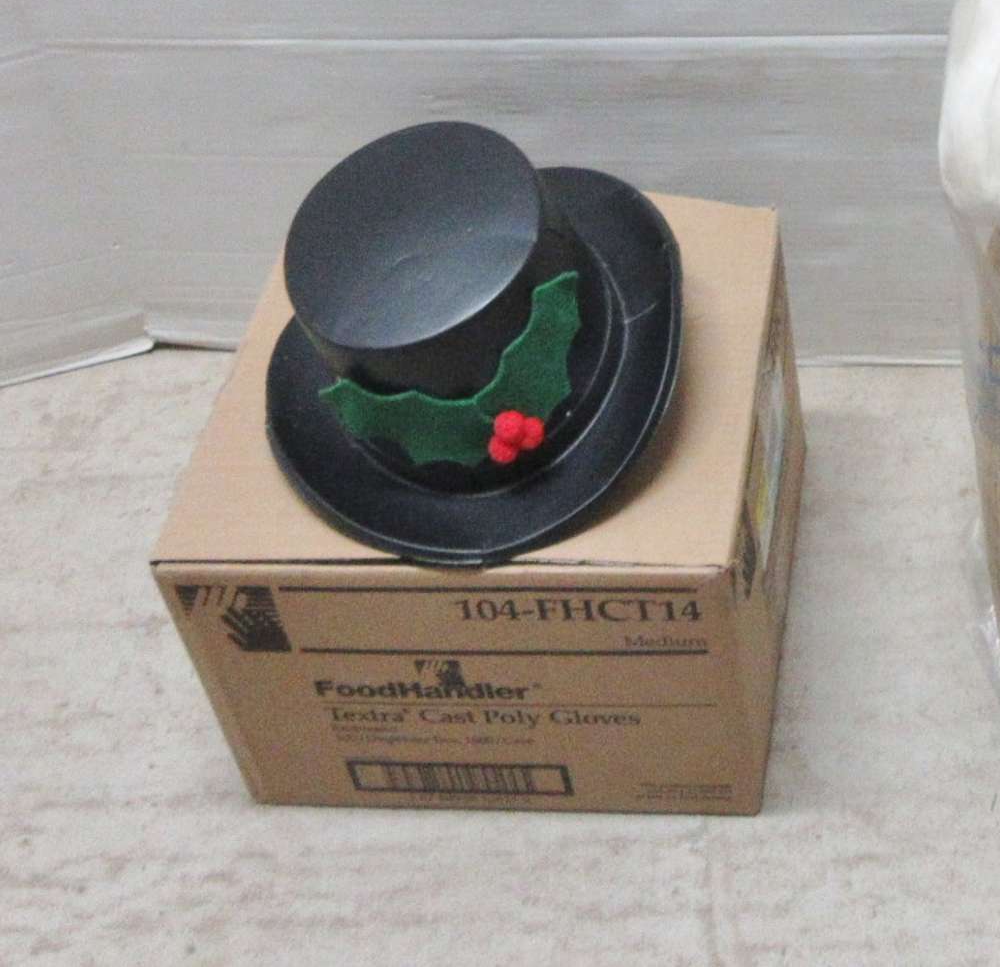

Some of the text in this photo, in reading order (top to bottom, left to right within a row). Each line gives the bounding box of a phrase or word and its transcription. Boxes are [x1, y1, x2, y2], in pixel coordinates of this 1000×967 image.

[455, 598, 702, 621] 104-FHCT14
[624, 636, 707, 649] Medium
[314, 680, 529, 700] FoodHandler
[418, 709, 477, 724] Cast
[484, 710, 541, 729] Poly
[550, 710, 641, 725] Gloves
